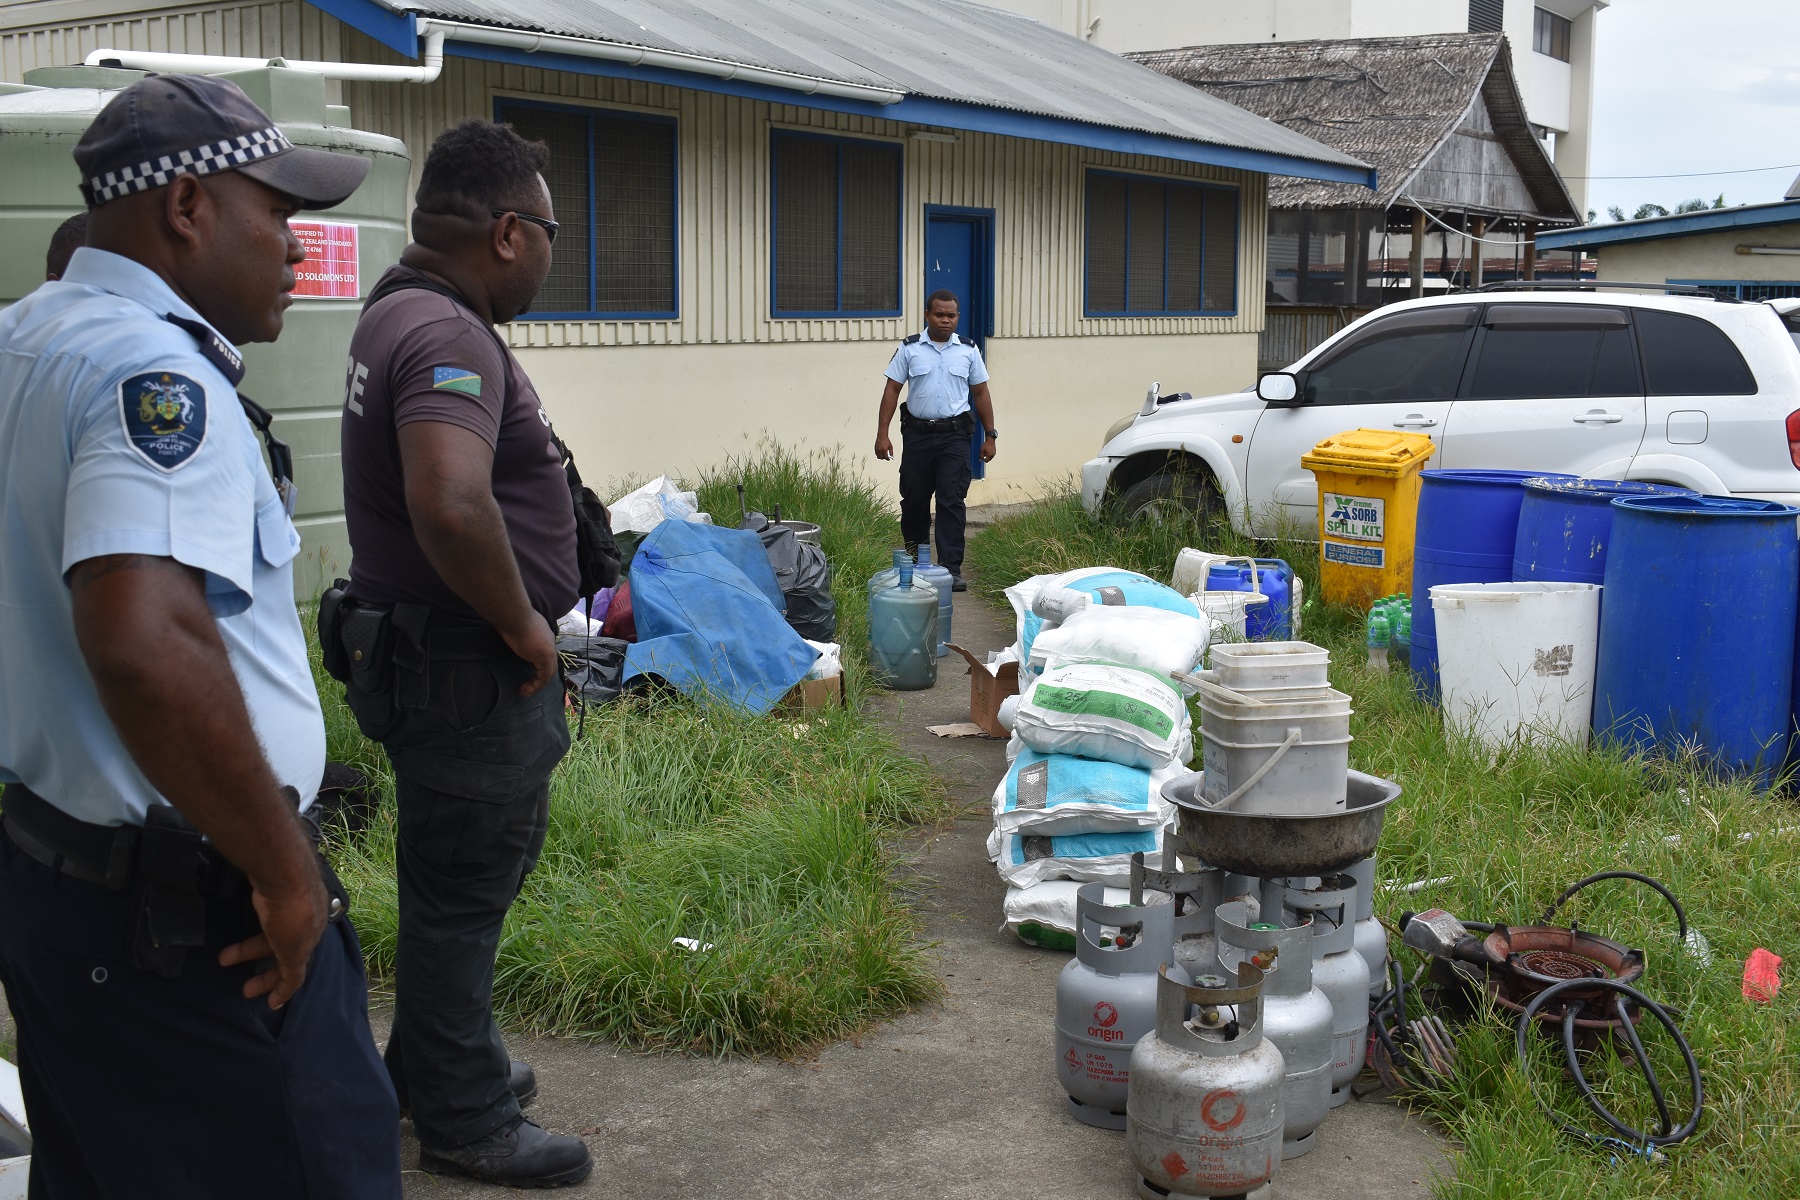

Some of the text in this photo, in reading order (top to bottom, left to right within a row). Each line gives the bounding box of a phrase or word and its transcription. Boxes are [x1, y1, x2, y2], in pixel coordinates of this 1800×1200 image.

[304, 272, 344, 282] SOLOMONS
[344, 274, 355, 283] LTD
[213, 337, 241, 370] POLICE
[150, 442, 185, 453] POLICE
[1327, 521, 1358, 535] SPILL
[1361, 524, 1381, 537] KIT
[1329, 545, 1378, 557] GENERAL
[1329, 552, 1378, 564] PURPOSE
[1087, 1026, 1124, 1042] origin
